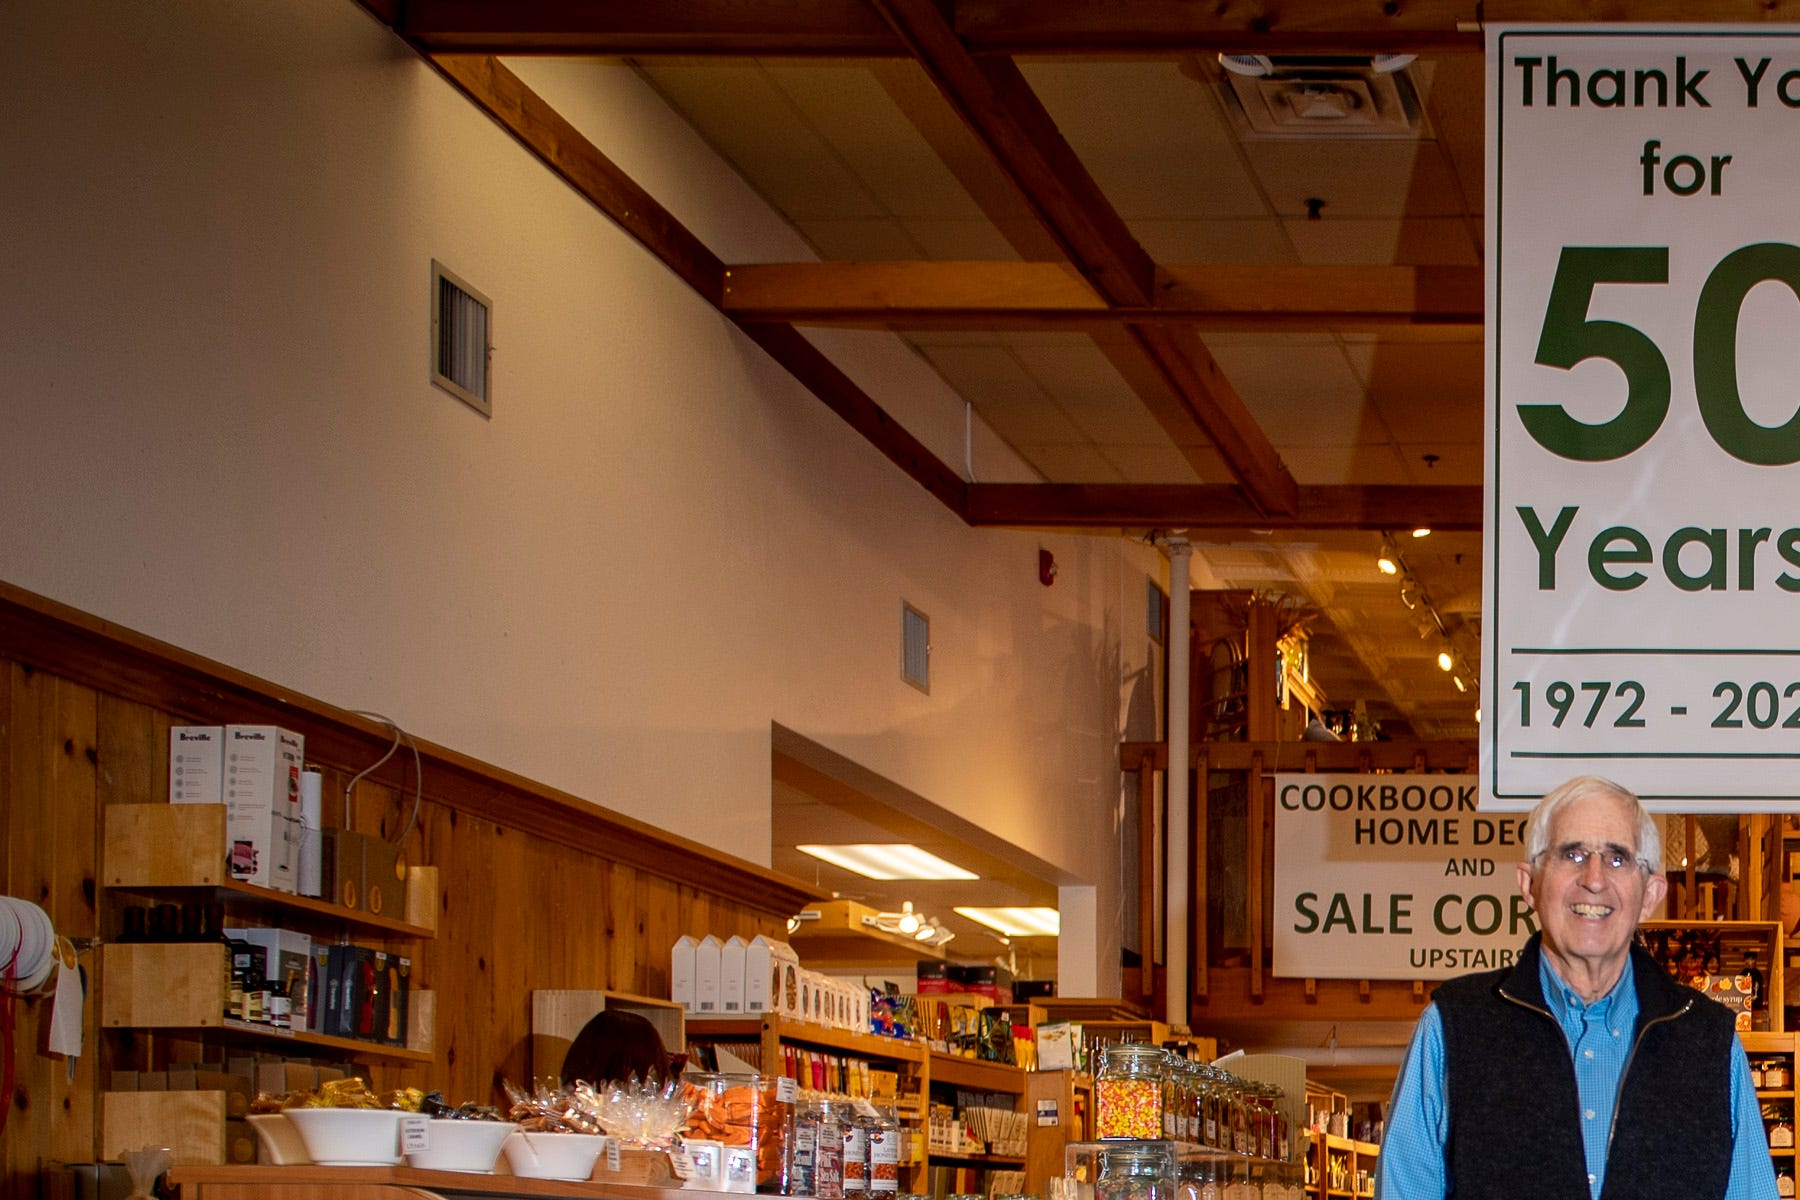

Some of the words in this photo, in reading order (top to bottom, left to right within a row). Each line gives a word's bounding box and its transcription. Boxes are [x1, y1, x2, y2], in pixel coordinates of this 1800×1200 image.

[1514, 56, 1712, 108] Thank
[1640, 139, 1733, 197] for
[1512, 680, 1646, 730] 1972
[1670, 705, 1688, 716] -
[180, 733, 211, 742] Breville
[234, 732, 266, 741] Breville
[1280, 784, 1479, 812] COOKBOOK
[1354, 818, 1460, 846] HOME
[1444, 857, 1496, 877] AND
[1293, 891, 1414, 935] SALE
